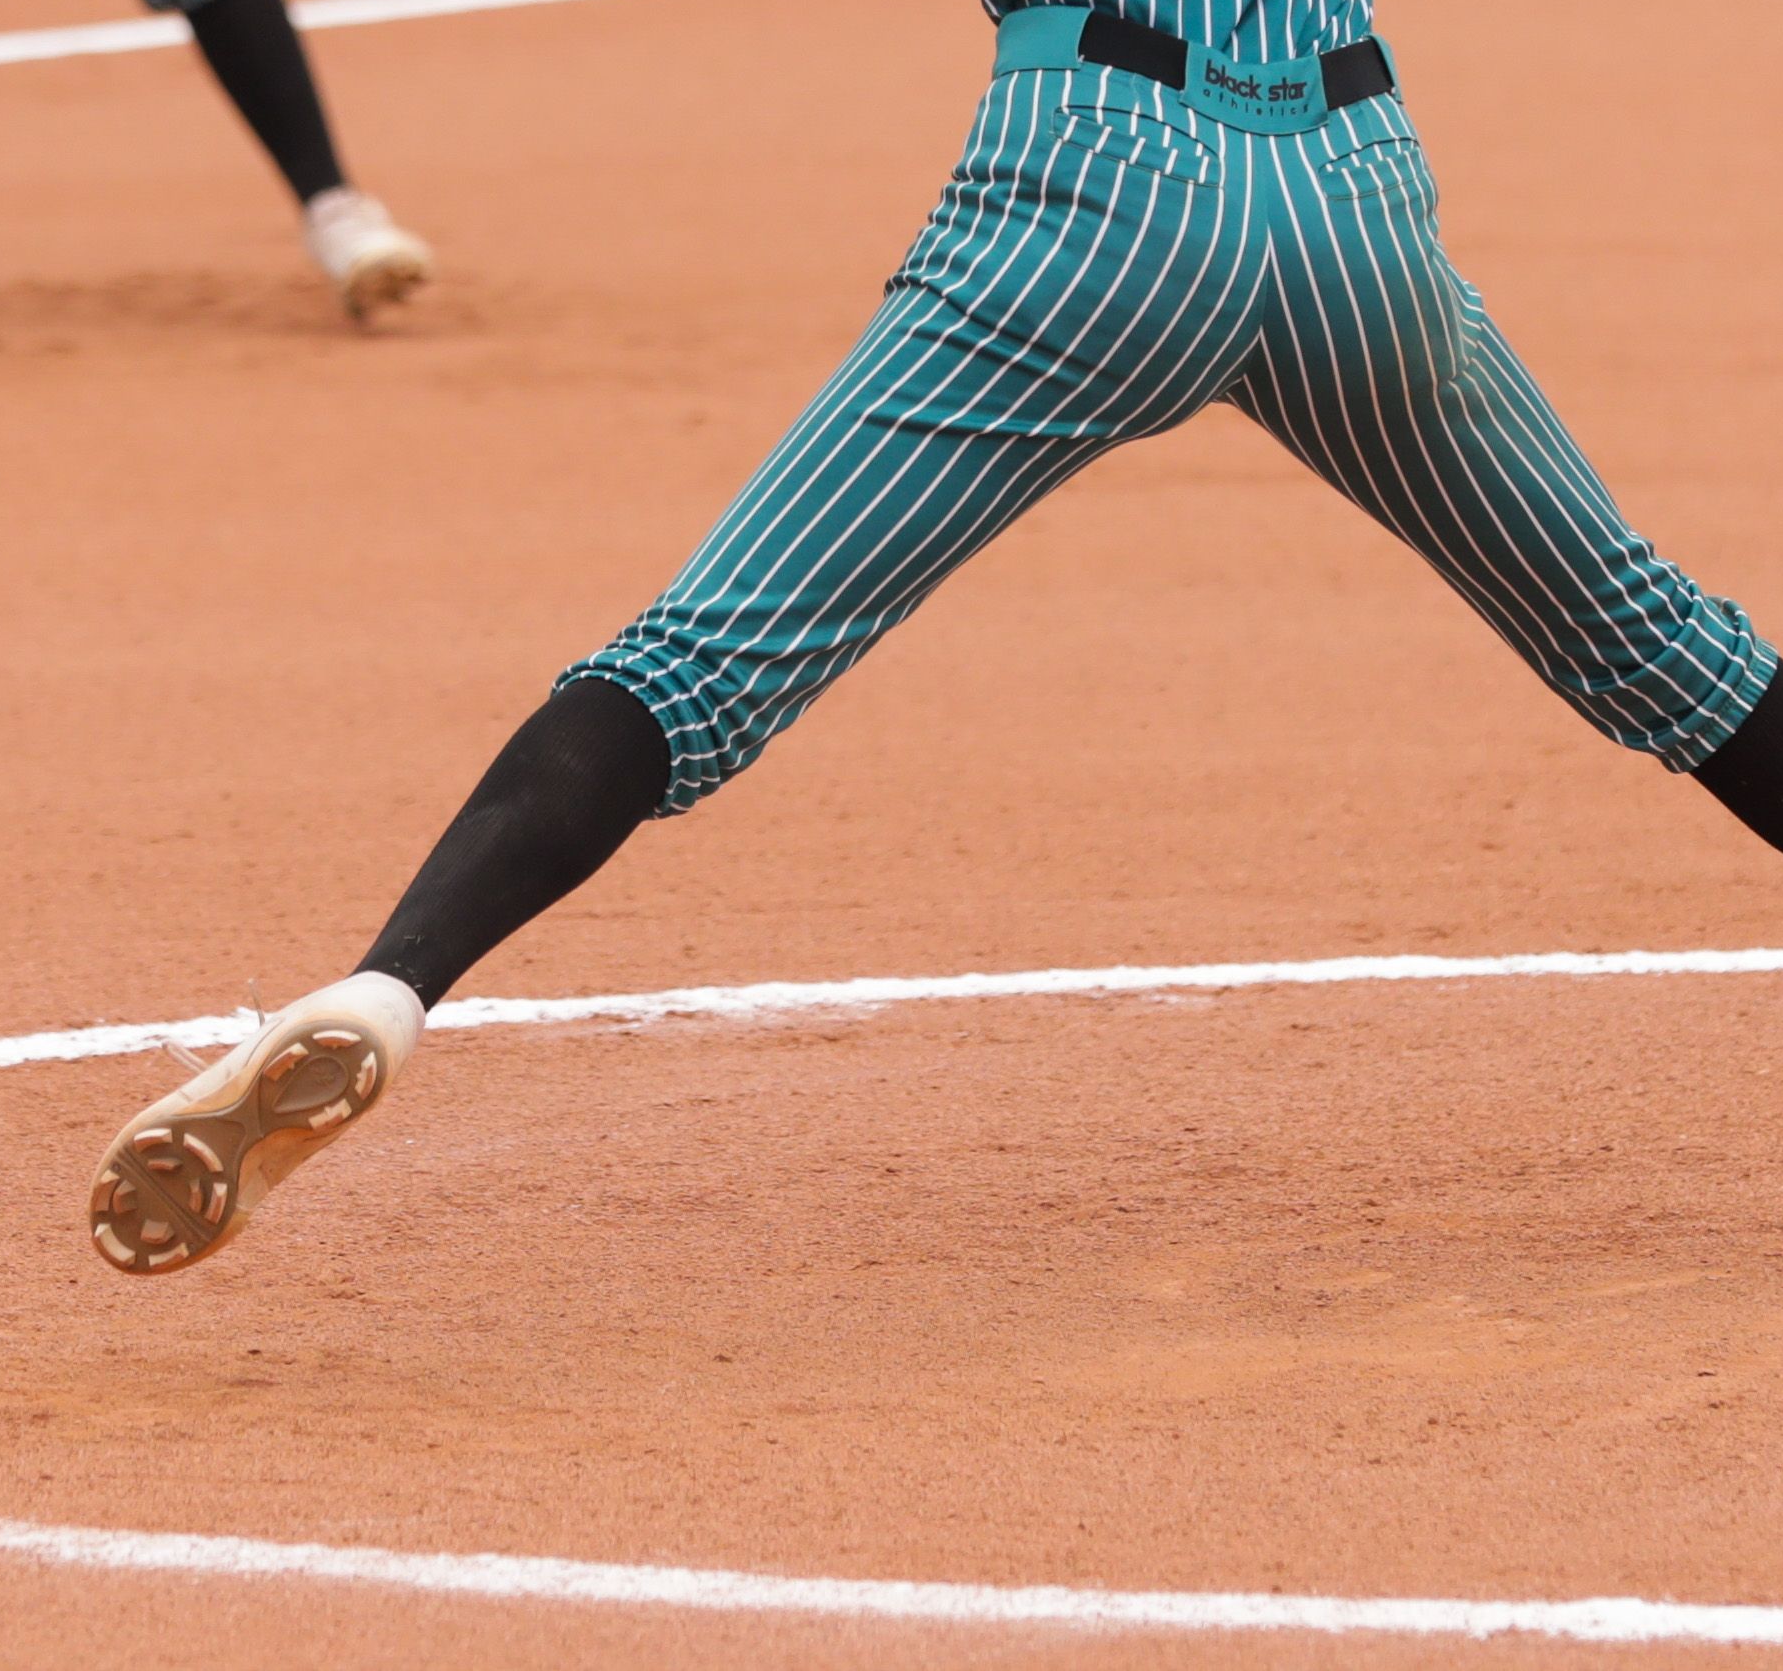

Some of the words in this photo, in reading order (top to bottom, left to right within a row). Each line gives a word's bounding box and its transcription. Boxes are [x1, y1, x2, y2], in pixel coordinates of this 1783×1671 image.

[1204, 58, 1263, 102] black
[1268, 76, 1308, 102] star
[1202, 88, 1309, 117] athletics
